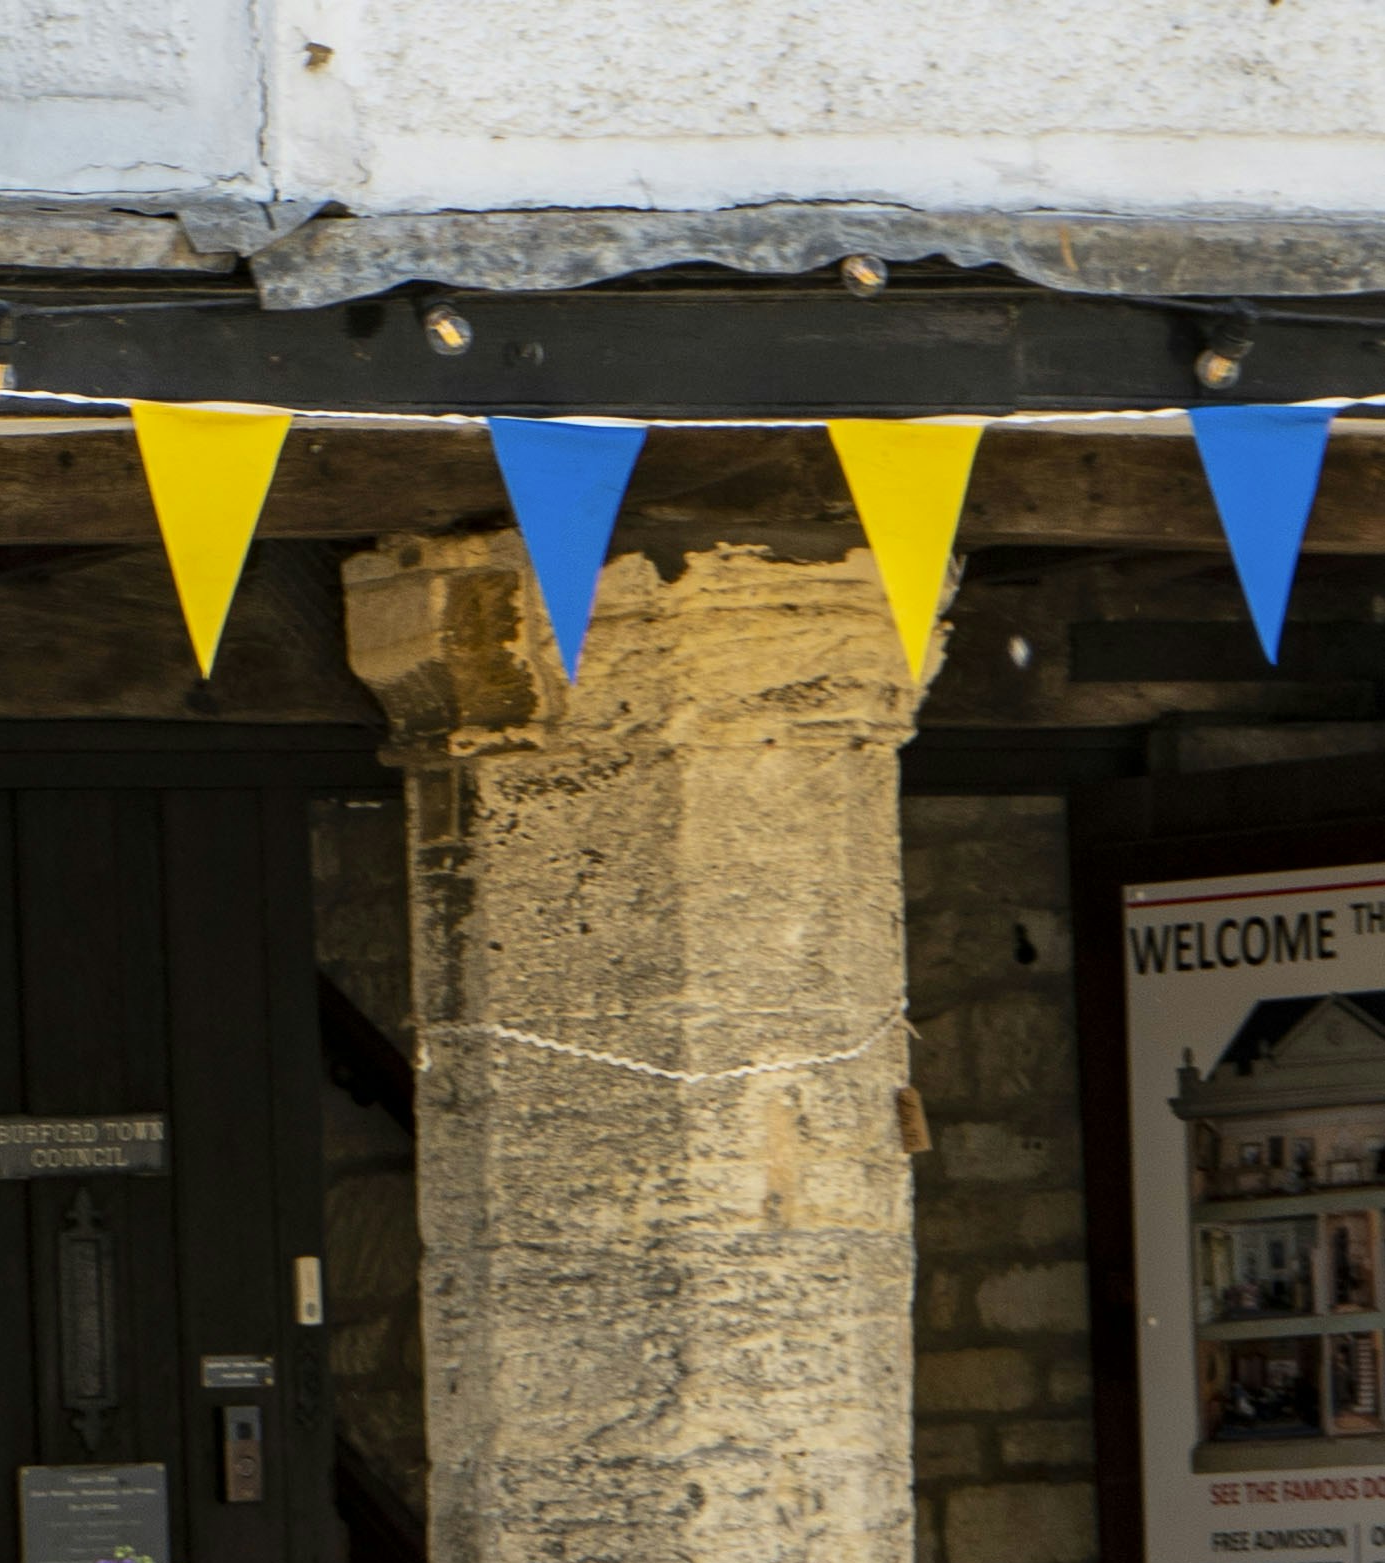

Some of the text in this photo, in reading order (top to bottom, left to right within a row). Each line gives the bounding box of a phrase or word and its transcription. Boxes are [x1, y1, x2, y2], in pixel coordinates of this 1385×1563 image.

[1130, 910, 1336, 974] WELCOME
[102, 1121, 164, 1141] TOWN
[30, 1147, 128, 1167] COUNCIL
[1245, 1481, 1279, 1502] THE
[1282, 1478, 1358, 1500] FAMOUS
[1211, 1531, 1250, 1551] FREE
[1254, 1528, 1346, 1550] ADMISSION
